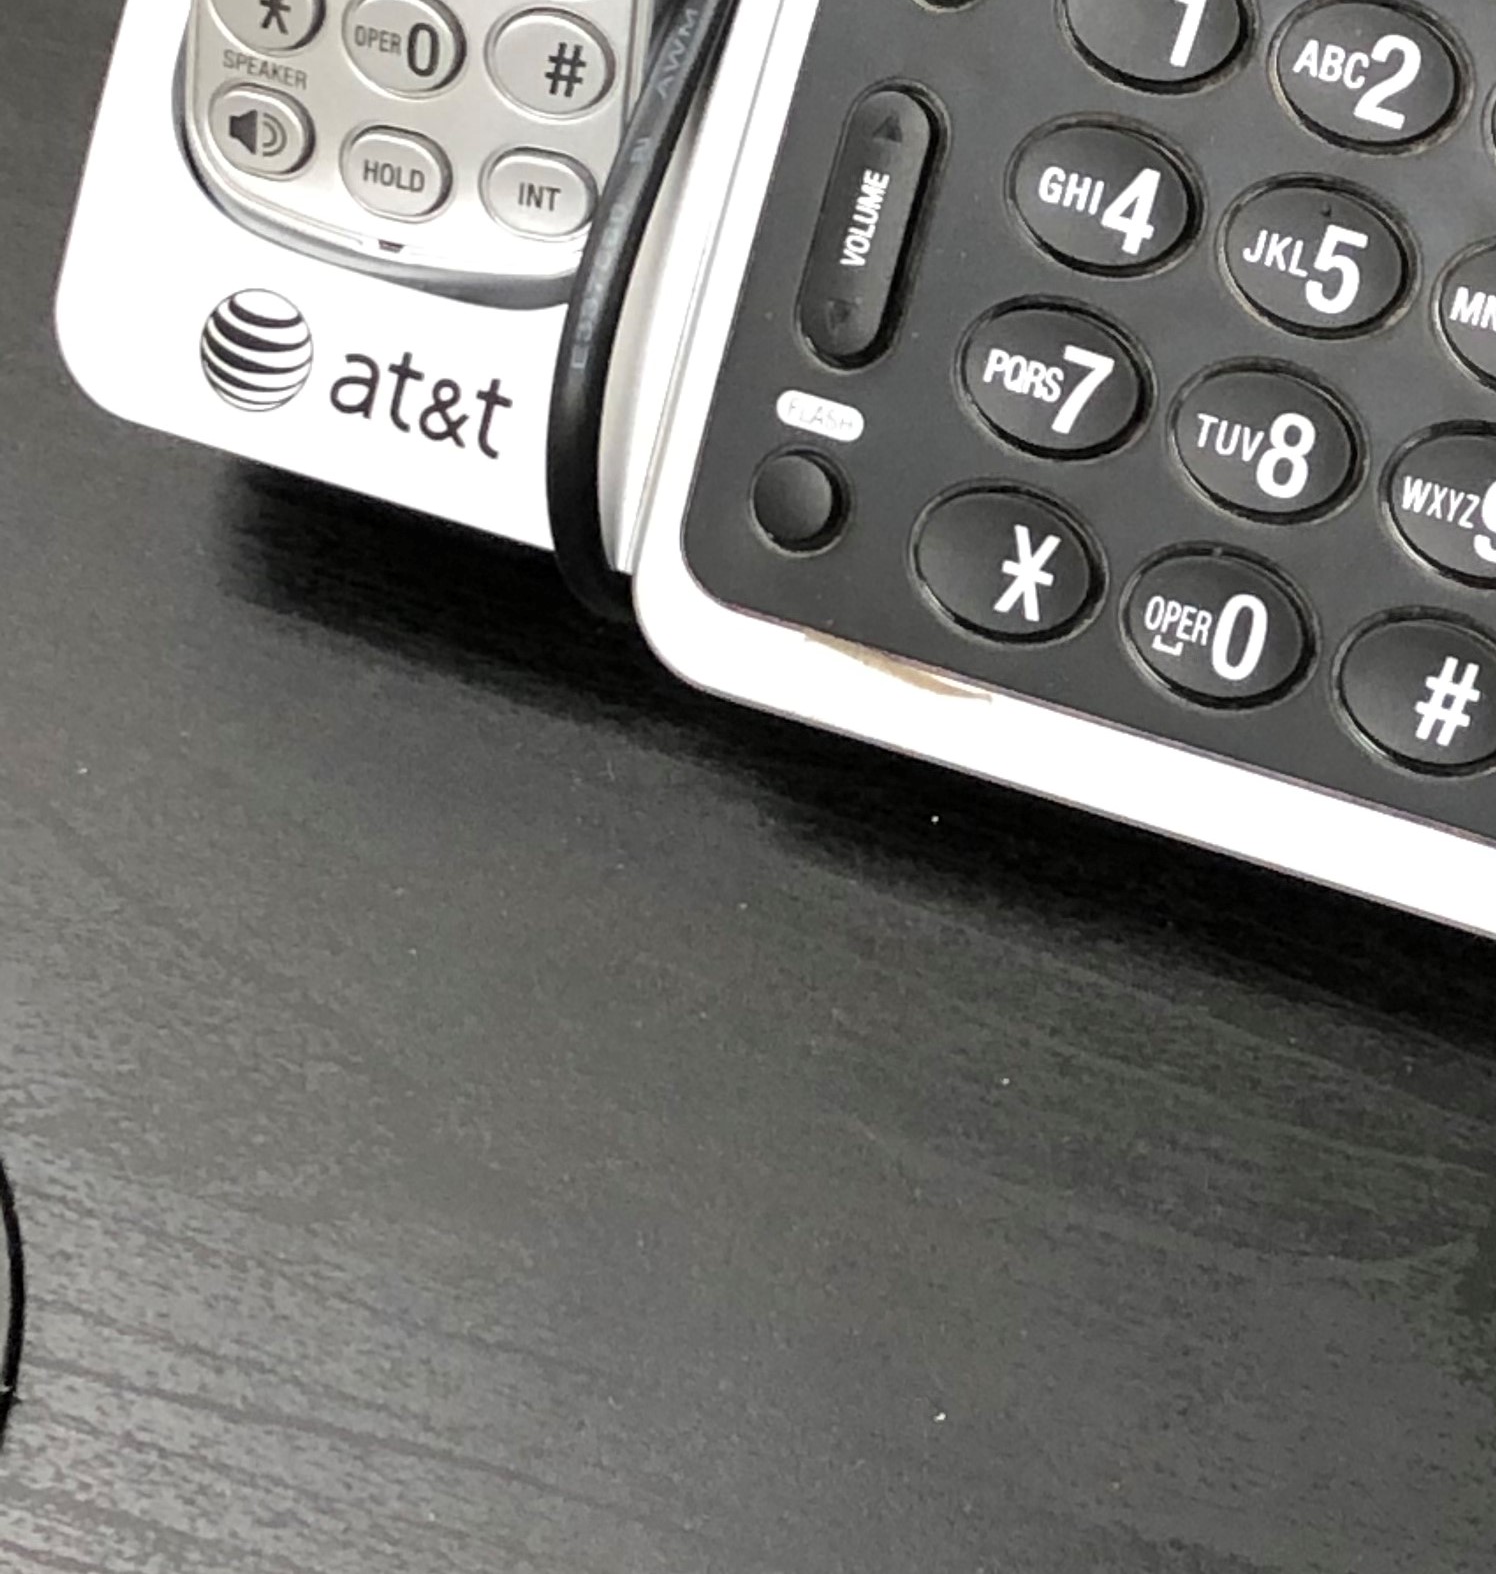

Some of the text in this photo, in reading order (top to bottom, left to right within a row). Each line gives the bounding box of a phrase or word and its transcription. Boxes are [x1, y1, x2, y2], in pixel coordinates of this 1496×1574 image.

[223, 48, 308, 91] SPEAKER
[657, 6, 700, 101] AWM
[1353, 33, 1422, 130] 2
[363, 159, 425, 194] HOLD
[517, 182, 561, 211] INT
[839, 168, 891, 269] VOLUME
[1101, 167, 1161, 255] 4
[1304, 223, 1368, 314] 5
[330, 351, 512, 459] at&t
[1051, 344, 1115, 434] 7
[1255, 413, 1316, 499] 8
